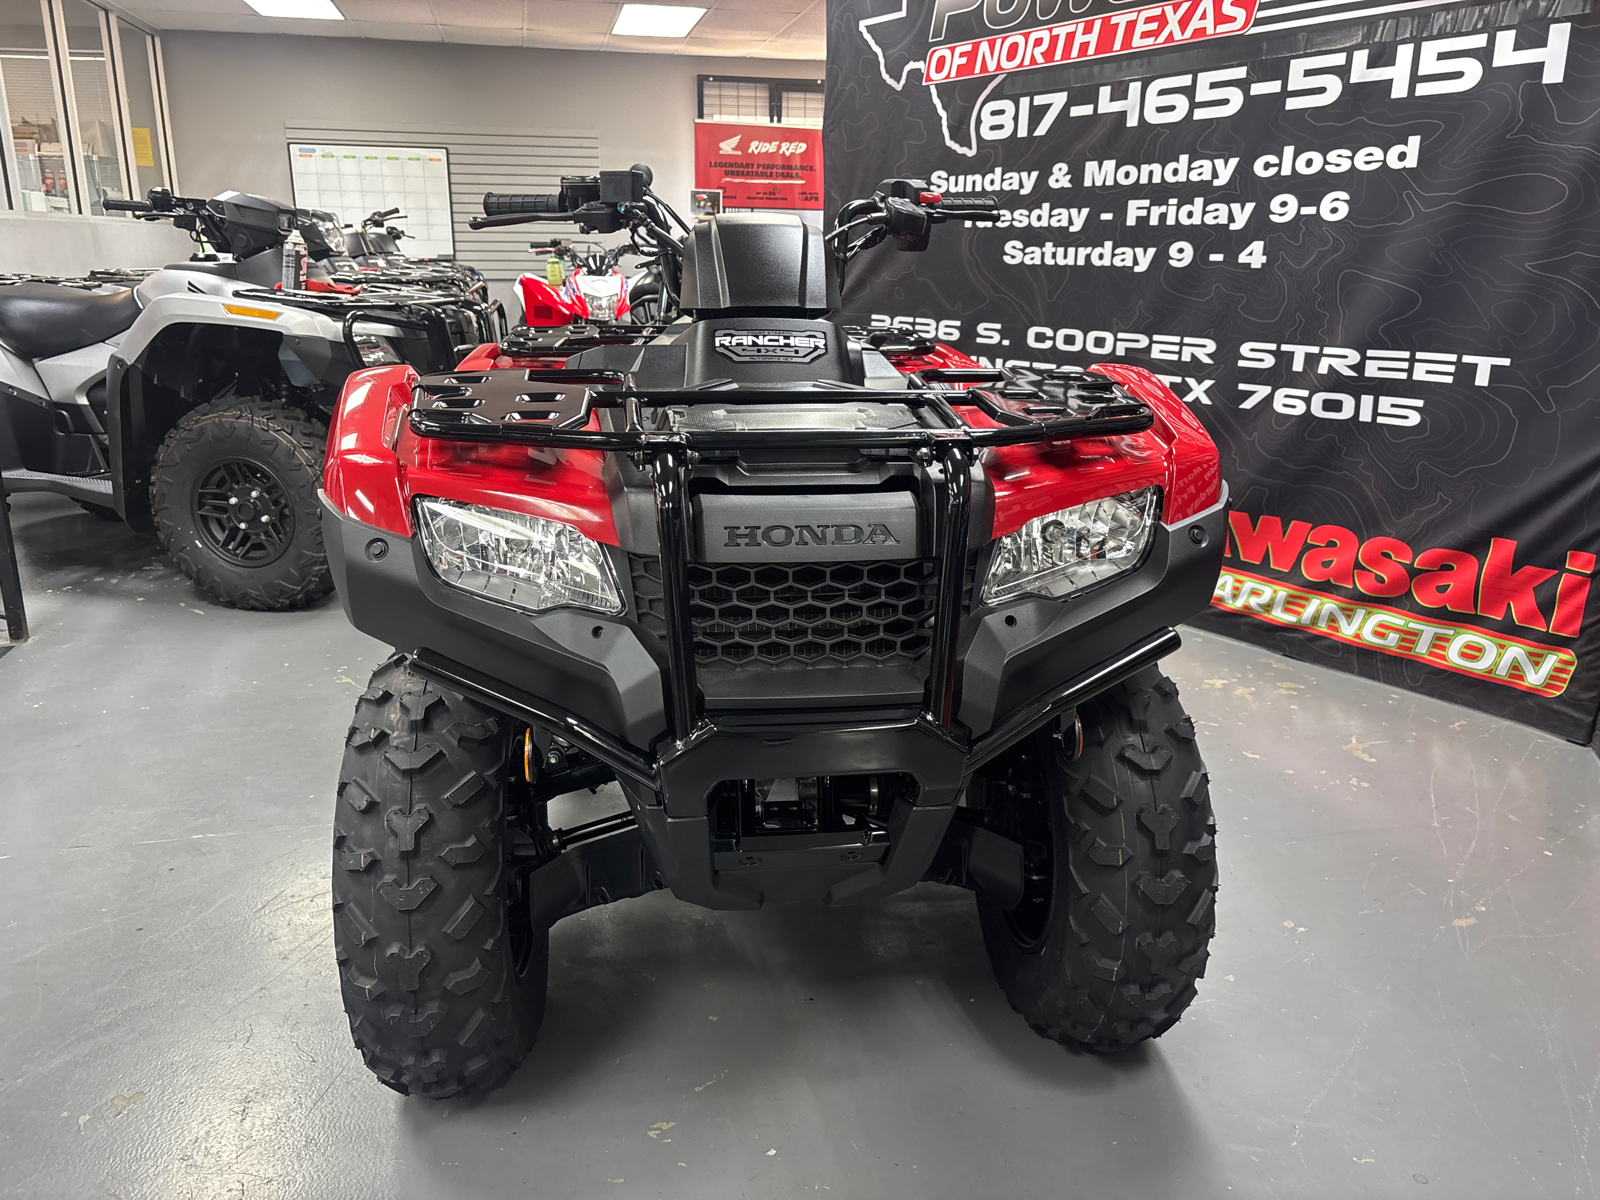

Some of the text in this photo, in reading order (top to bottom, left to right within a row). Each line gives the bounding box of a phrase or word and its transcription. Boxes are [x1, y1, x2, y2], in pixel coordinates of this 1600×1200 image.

[929, 48, 967, 81] OF
[975, 19, 1103, 74] NORTH
[1111, 0, 1249, 52] TEXAS
[979, 22, 1571, 140] 817-465-5454
[709, 161, 755, 170] LEGENDARY
[747, 140, 808, 157] RIDE RED
[929, 135, 1422, 195] Sunday & Monday closed
[724, 170, 802, 179] UNBEATABLE DEALS.
[963, 191, 1351, 232] esday - Friday 9-6
[1002, 240, 1267, 272] Saturday 9 - 4
[715, 336, 826, 348] RANCHER
[976, 322, 1010, 346] S.
[1027, 327, 1216, 365] COOPER
[1237, 340, 1512, 387] STREET
[1237, 382, 1425, 427] 76015
[723, 524, 900, 547] HONDA
[1215, 575, 1558, 686] ARLINGTON
